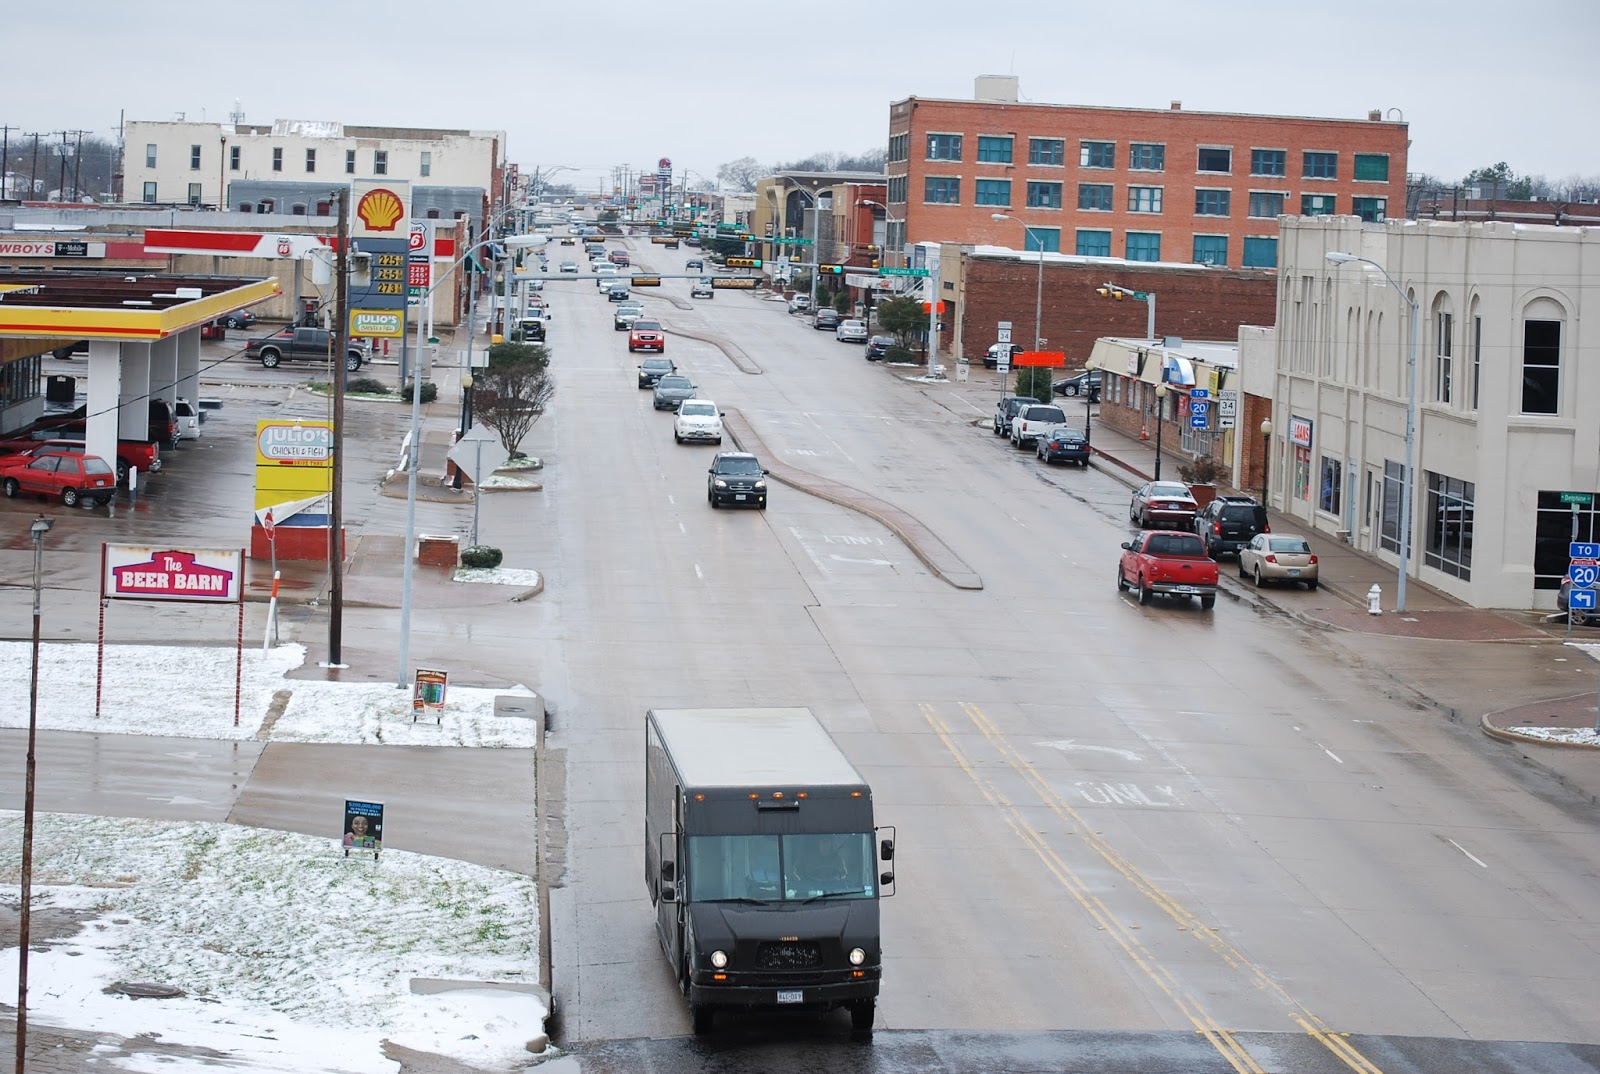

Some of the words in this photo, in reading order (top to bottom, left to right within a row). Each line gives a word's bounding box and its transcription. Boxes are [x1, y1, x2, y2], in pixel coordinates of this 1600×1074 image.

[357, 314, 398, 324] JULIO'S
[1193, 404, 1206, 413] 20
[1222, 401, 1233, 410] 34
[266, 428, 329, 445] JULIO'S
[1295, 423, 1309, 442] LOANS
[272, 446, 300, 455] CHICKEN
[308, 447, 324, 456] FISH
[1578, 546, 1592, 555] TO
[164, 557, 183, 572] The
[121, 571, 169, 588] BEER
[174, 573, 224, 591] BARN
[1574, 568, 1595, 583] 20
